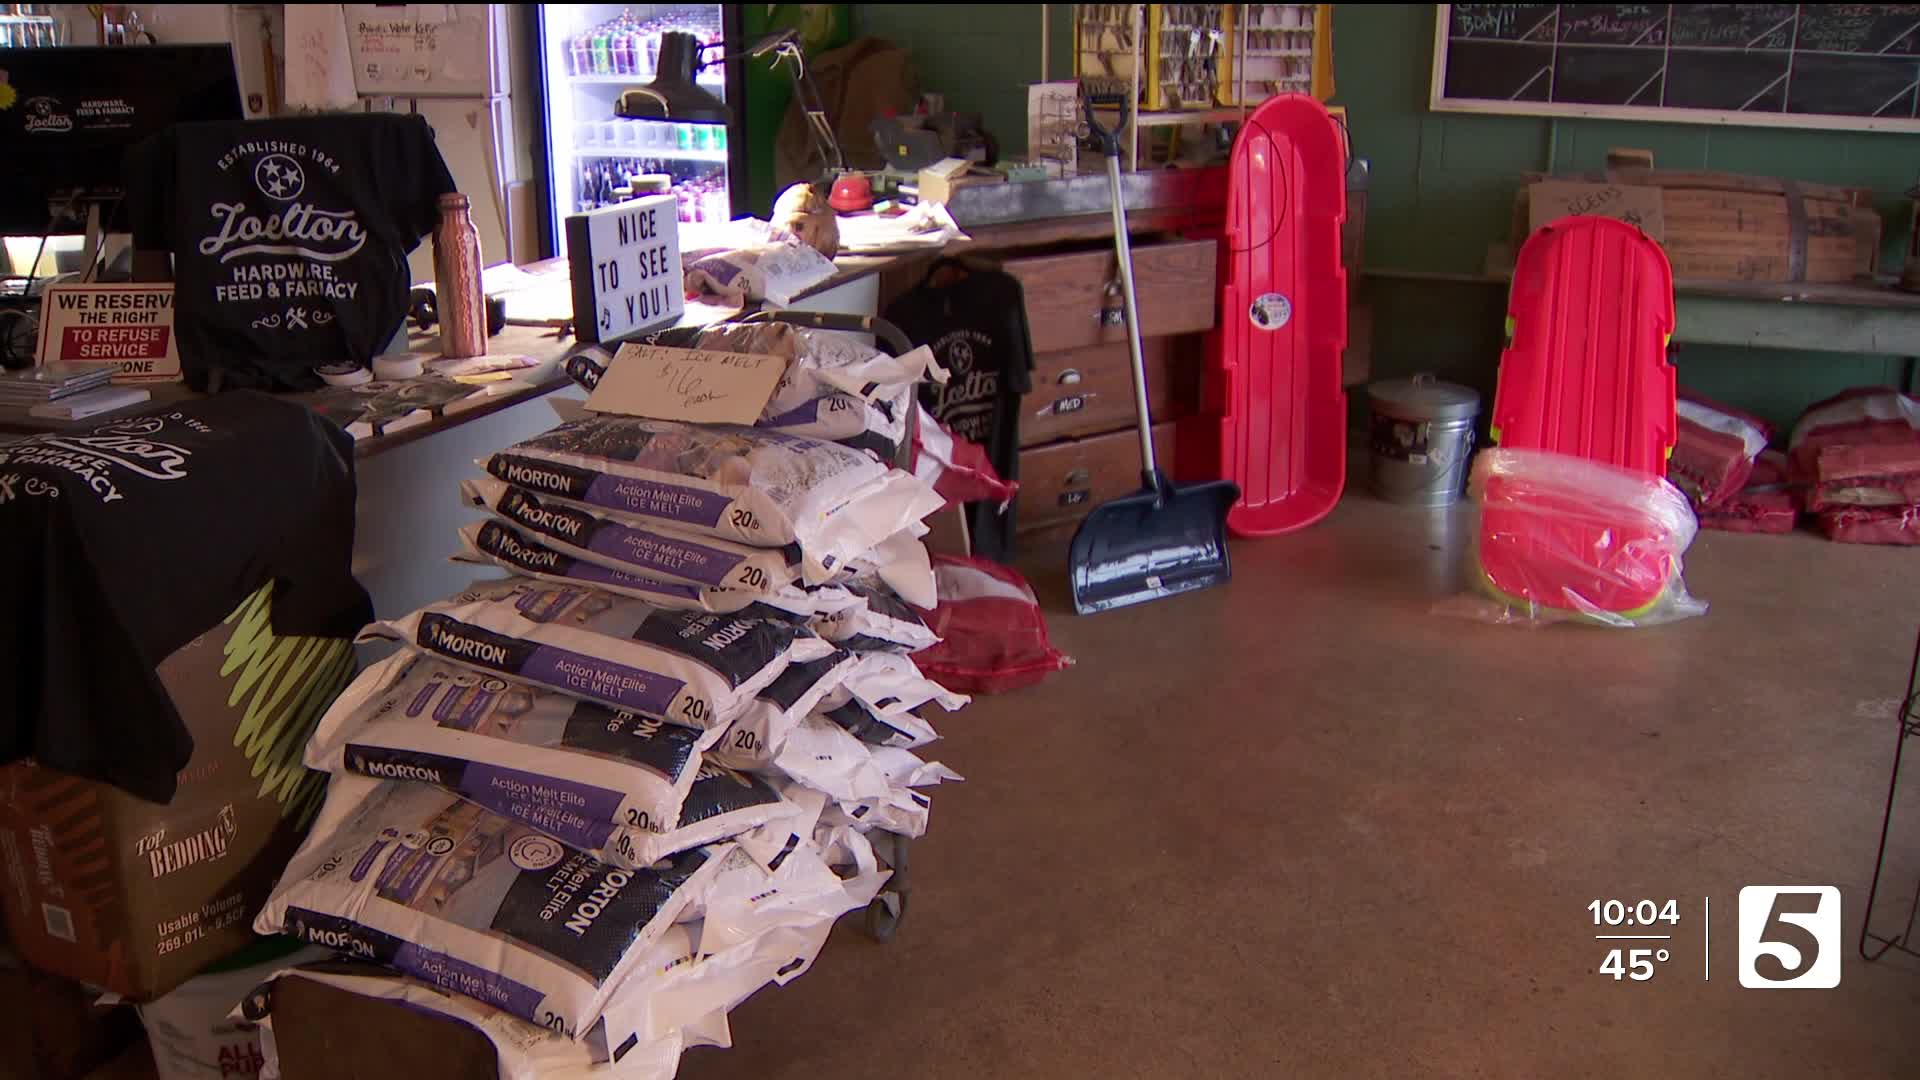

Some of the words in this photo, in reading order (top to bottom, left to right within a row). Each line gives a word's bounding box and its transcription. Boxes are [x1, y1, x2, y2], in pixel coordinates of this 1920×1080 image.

[217, 140, 307, 171] ESTABLISHED
[312, 149, 341, 174] 1964
[199, 202, 368, 261] Joelton
[618, 209, 657, 246] NICE
[233, 263, 339, 282] HARDWRE,
[598, 260, 619, 293] TO
[639, 246, 669, 280] SEE
[58, 294, 88, 309] WE
[216, 284, 263, 302] FEED
[267, 282, 281, 298] &
[285, 281, 359, 300] FARACY
[626, 284, 670, 325] YOU!
[79, 311, 108, 324] THE
[112, 311, 158, 324] RIGHT
[72, 329, 93, 342] TO
[97, 329, 161, 341] REFUSE
[79, 343, 150, 358] SERVICE
[13, 454, 124, 503] FARMACY
[508, 465, 571, 492] MORTON
[615, 483, 651, 498] Action
[653, 489, 679, 504] Melt
[679, 494, 703, 508] Elite
[627, 496, 646, 509] ICE
[650, 501, 680, 515] MELT
[516, 503, 582, 537] MORTON
[732, 509, 752, 528] 20
[500, 535, 558, 567] MORTON
[624, 535, 658, 551] Action
[659, 543, 683, 559] Melt
[683, 551, 707, 565] Elite
[632, 547, 649, 559] ICE
[653, 552, 684, 569] MELT
[739, 566, 763, 586] 20
[438, 632, 507, 664] MORTON
[555, 659, 594, 679] Action
[596, 670, 622, 688] Melt
[621, 677, 647, 694] Elite
[567, 674, 588, 688] ICE
[591, 681, 624, 699] MELT
[682, 696, 704, 719] 20
[735, 729, 756, 749] 20
[368, 760, 441, 783] MORTON
[491, 777, 529, 793] Action
[531, 785, 558, 801] Melt
[560, 791, 586, 807] Elite
[532, 812, 562, 832] MELT
[561, 811, 585, 830] Elite
[627, 808, 649, 828] 20
[150, 826, 227, 879] BEDDING
[157, 911, 200, 937] Usable
[201, 893, 243, 918] Volume
[540, 891, 572, 921] Elite
[157, 926, 206, 955] 269.01L
[545, 1011, 564, 1033] 20
